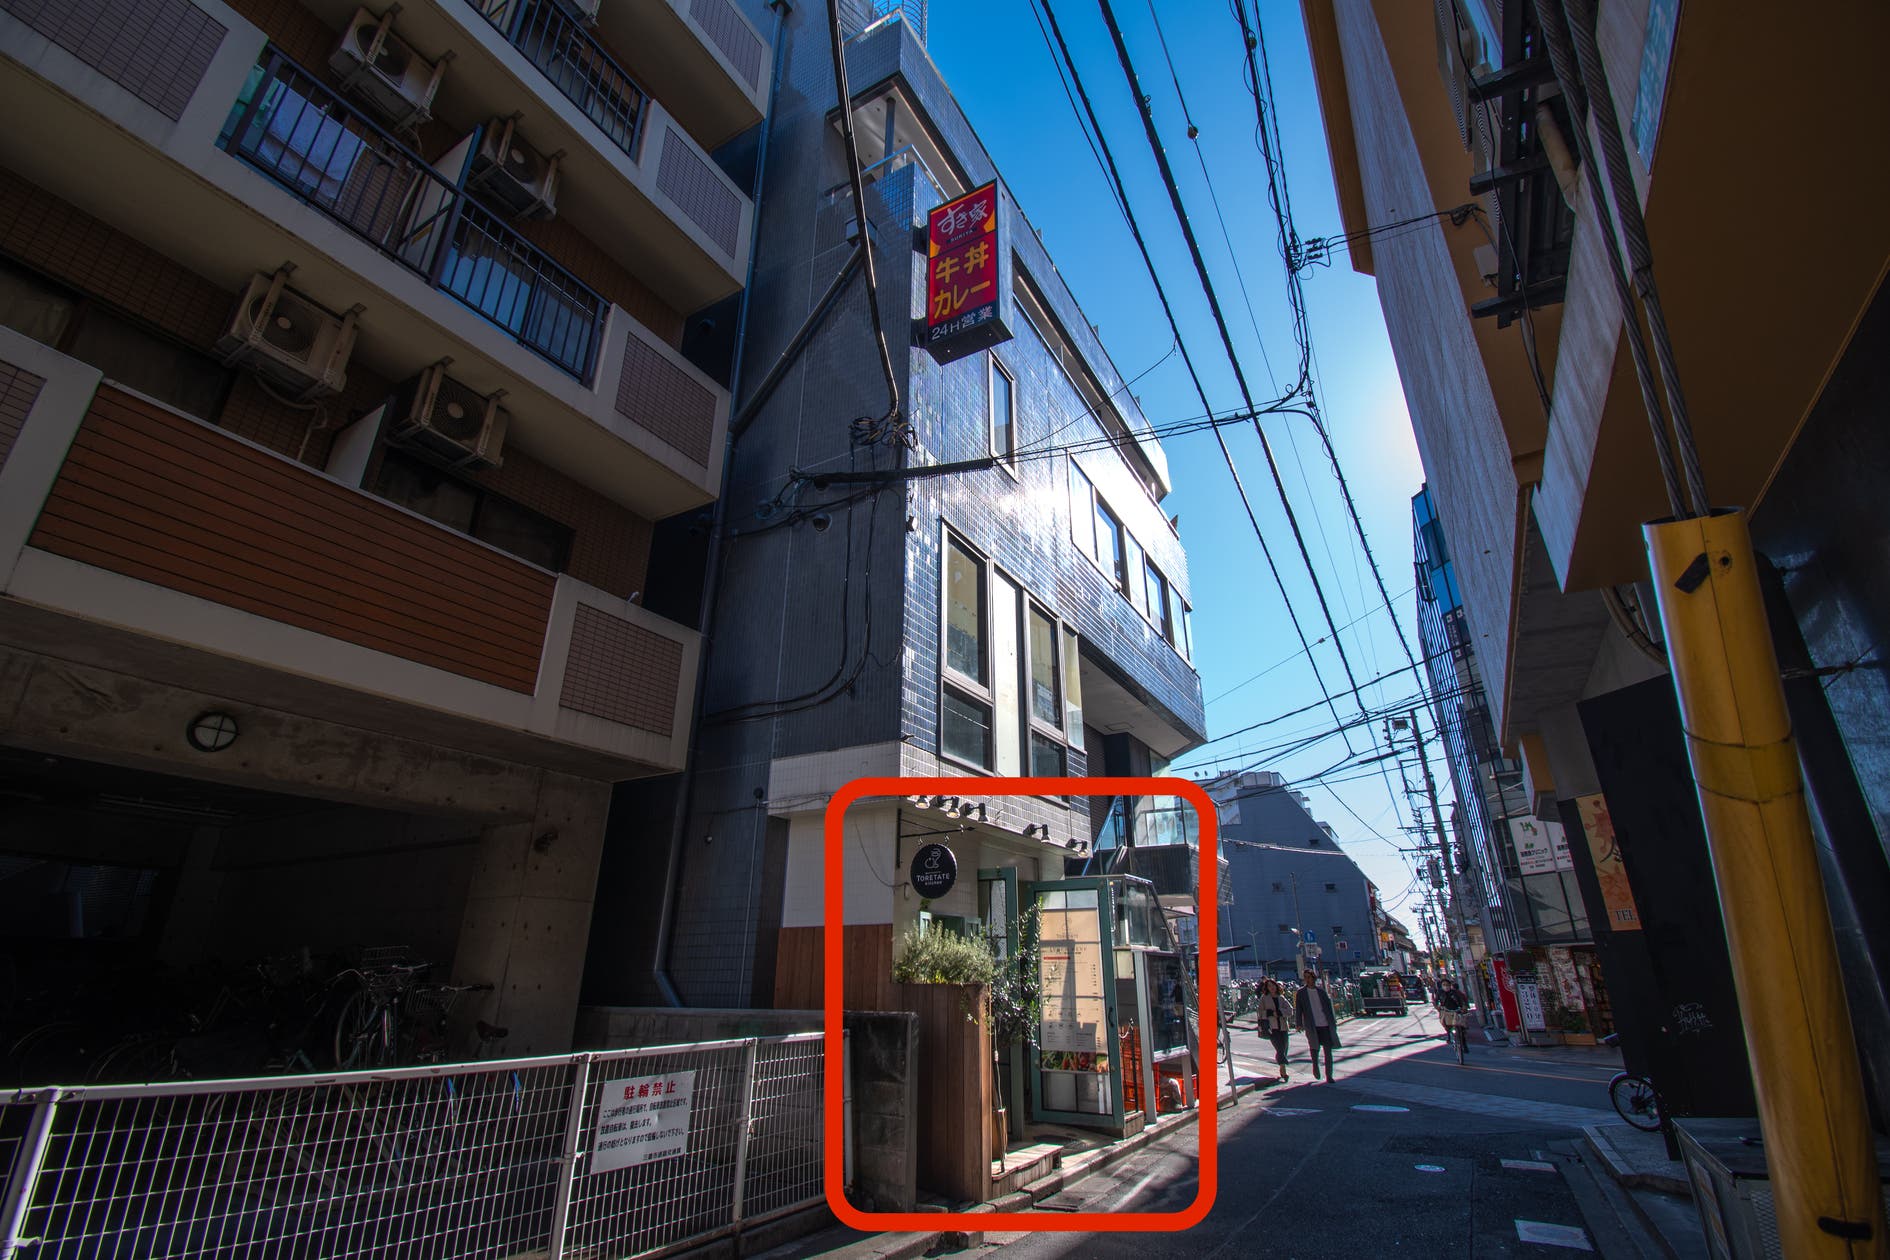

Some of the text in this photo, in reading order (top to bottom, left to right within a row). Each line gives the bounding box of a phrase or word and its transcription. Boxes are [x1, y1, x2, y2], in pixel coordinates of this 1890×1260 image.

[937, 199, 988, 236] すき家
[935, 241, 989, 284] 牛丼
[934, 280, 991, 319] カレー
[931, 305, 993, 340] 24H営業
[916, 872, 951, 882] TORETATE
[623, 1080, 676, 1101] 駐輪禁止
